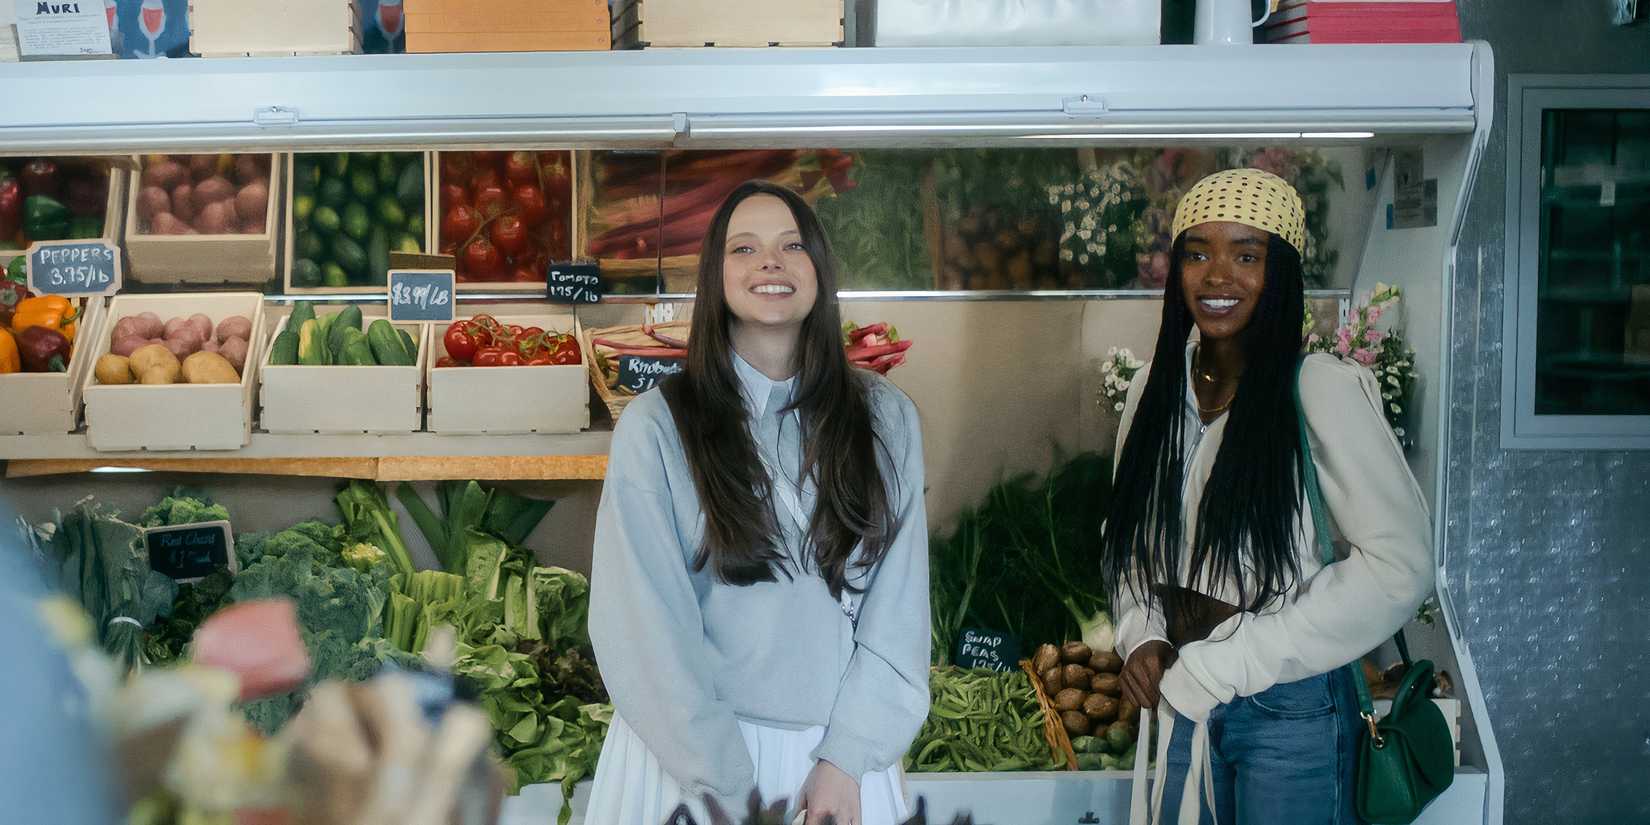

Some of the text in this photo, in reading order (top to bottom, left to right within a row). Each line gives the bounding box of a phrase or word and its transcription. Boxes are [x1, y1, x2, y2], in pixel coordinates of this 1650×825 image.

[36, 1, 81, 15] MURI
[40, 247, 113, 265] PEPPERS
[962, 643, 999, 662] PEAS
